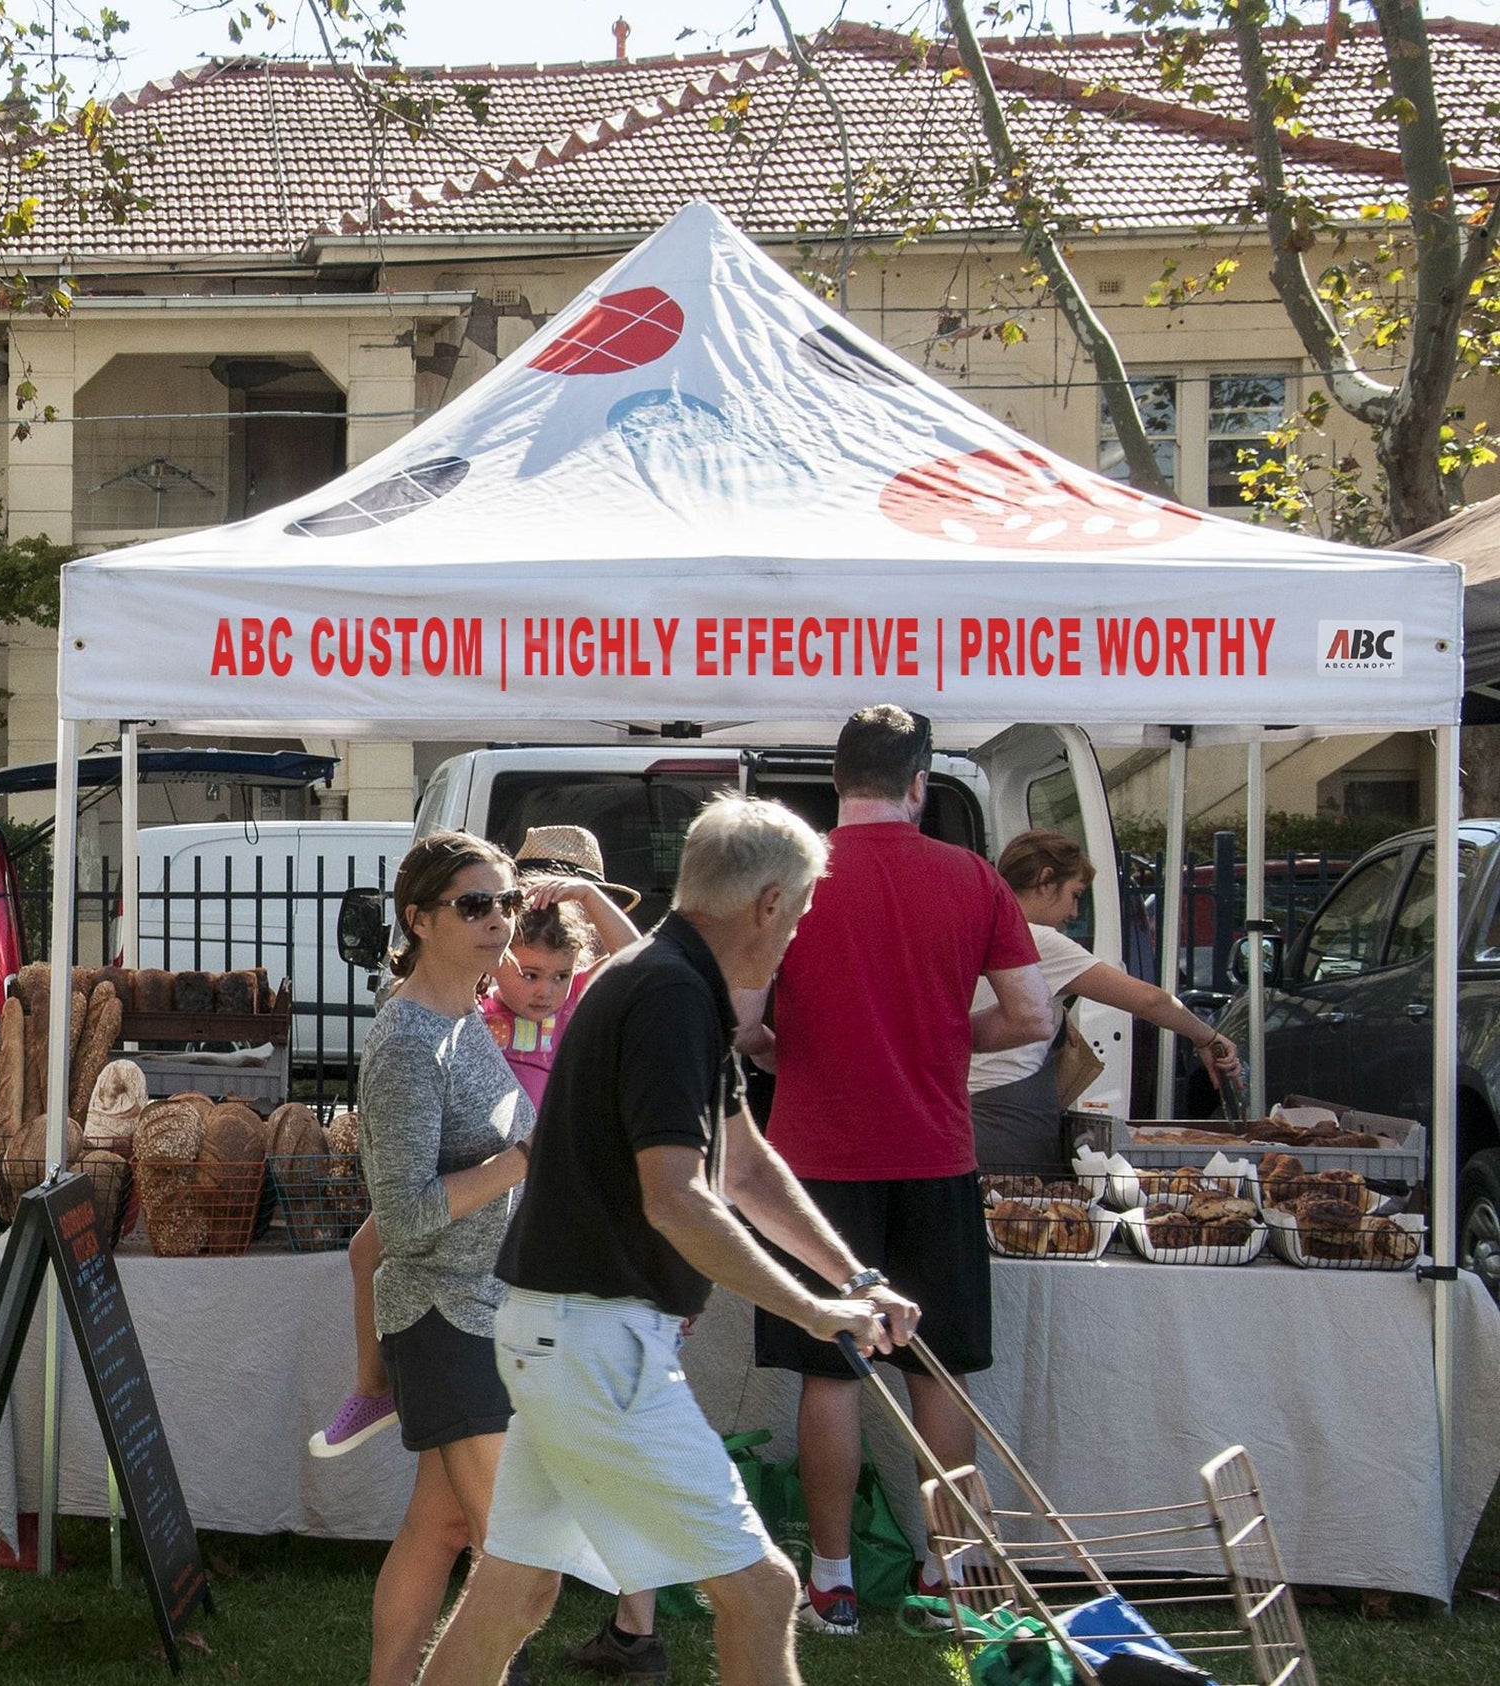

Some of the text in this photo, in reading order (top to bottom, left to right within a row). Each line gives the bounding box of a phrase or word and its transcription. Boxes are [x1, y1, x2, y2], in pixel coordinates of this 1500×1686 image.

[211, 616, 293, 677] ABC
[310, 616, 482, 677] CUSTOM
[524, 616, 680, 677] HIGHLY
[696, 616, 918, 677] EFFECTIVE
[960, 616, 1081, 677] PRICE
[1096, 616, 1275, 677] WORTHY
[1326, 629, 1395, 660] ABC
